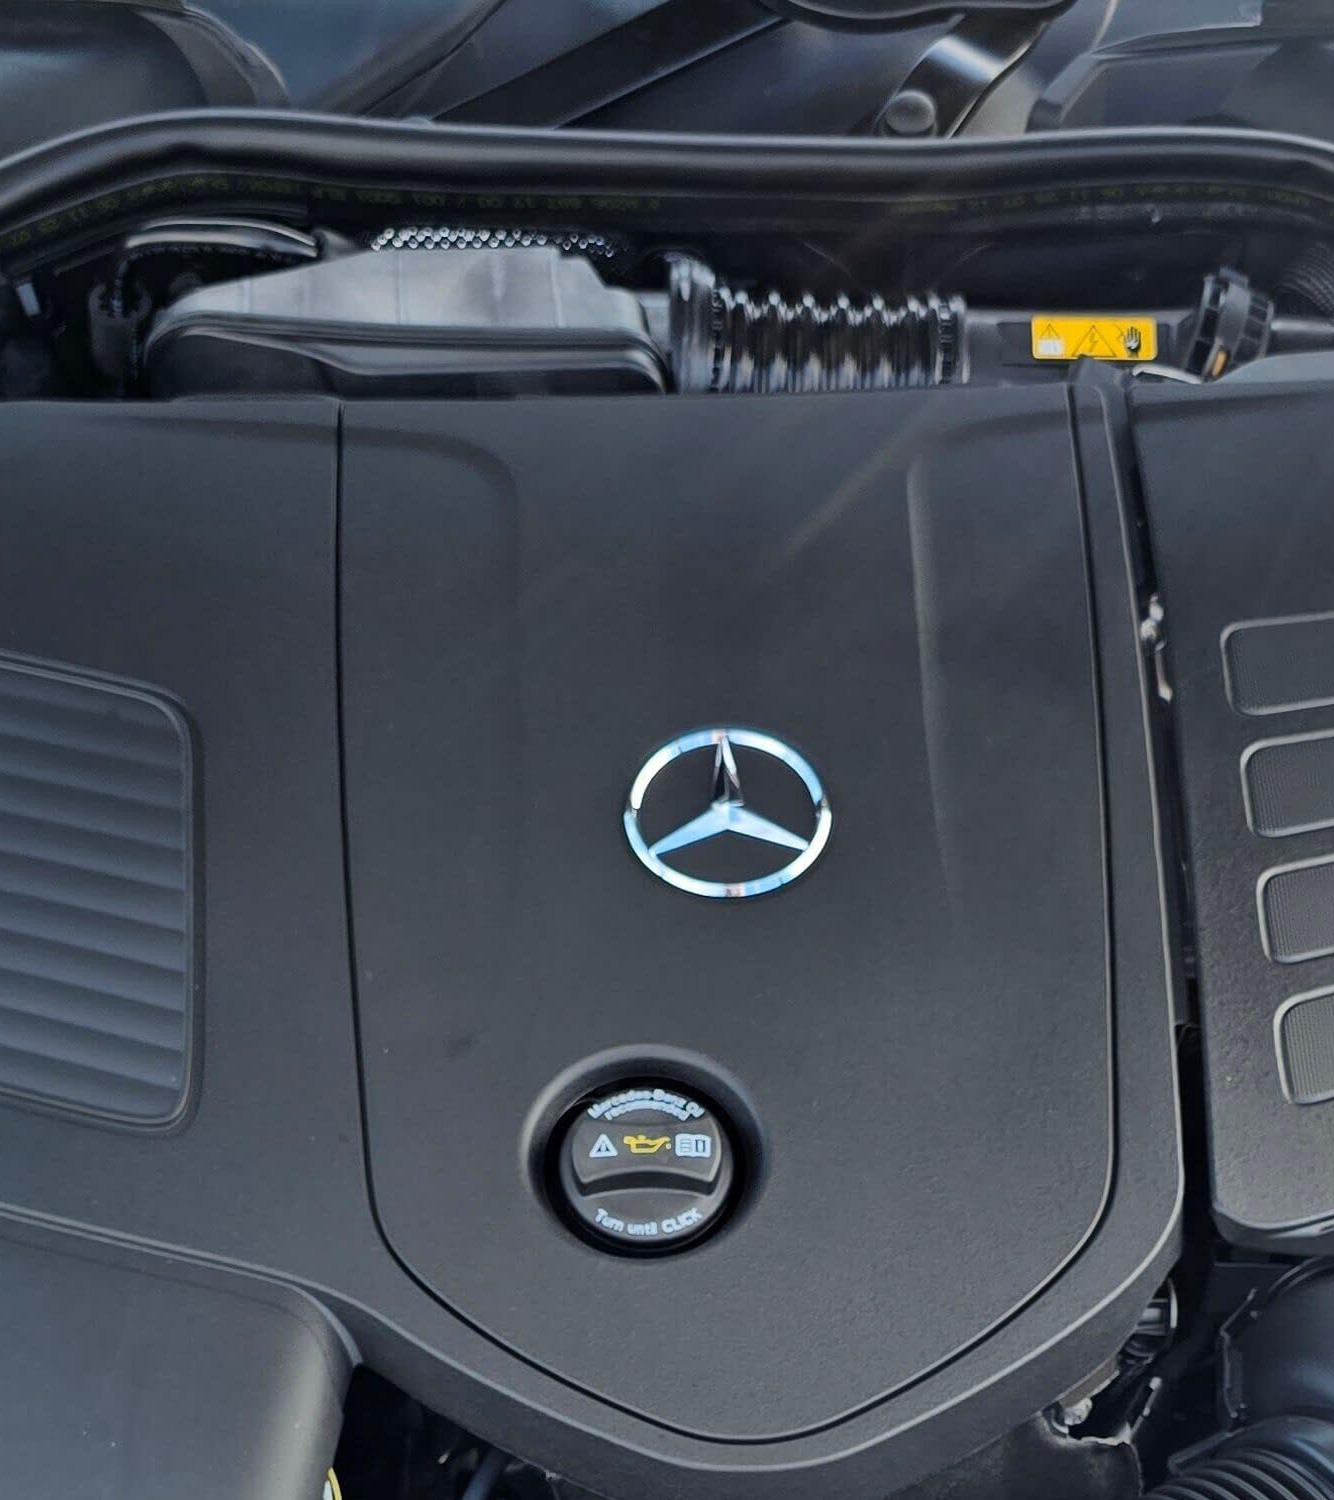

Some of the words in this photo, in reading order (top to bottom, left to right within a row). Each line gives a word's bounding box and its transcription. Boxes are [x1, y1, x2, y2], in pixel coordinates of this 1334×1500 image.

[594, 1208, 625, 1232] Turn
[627, 1221, 658, 1236] until
[661, 1207, 704, 1234] CLICK
